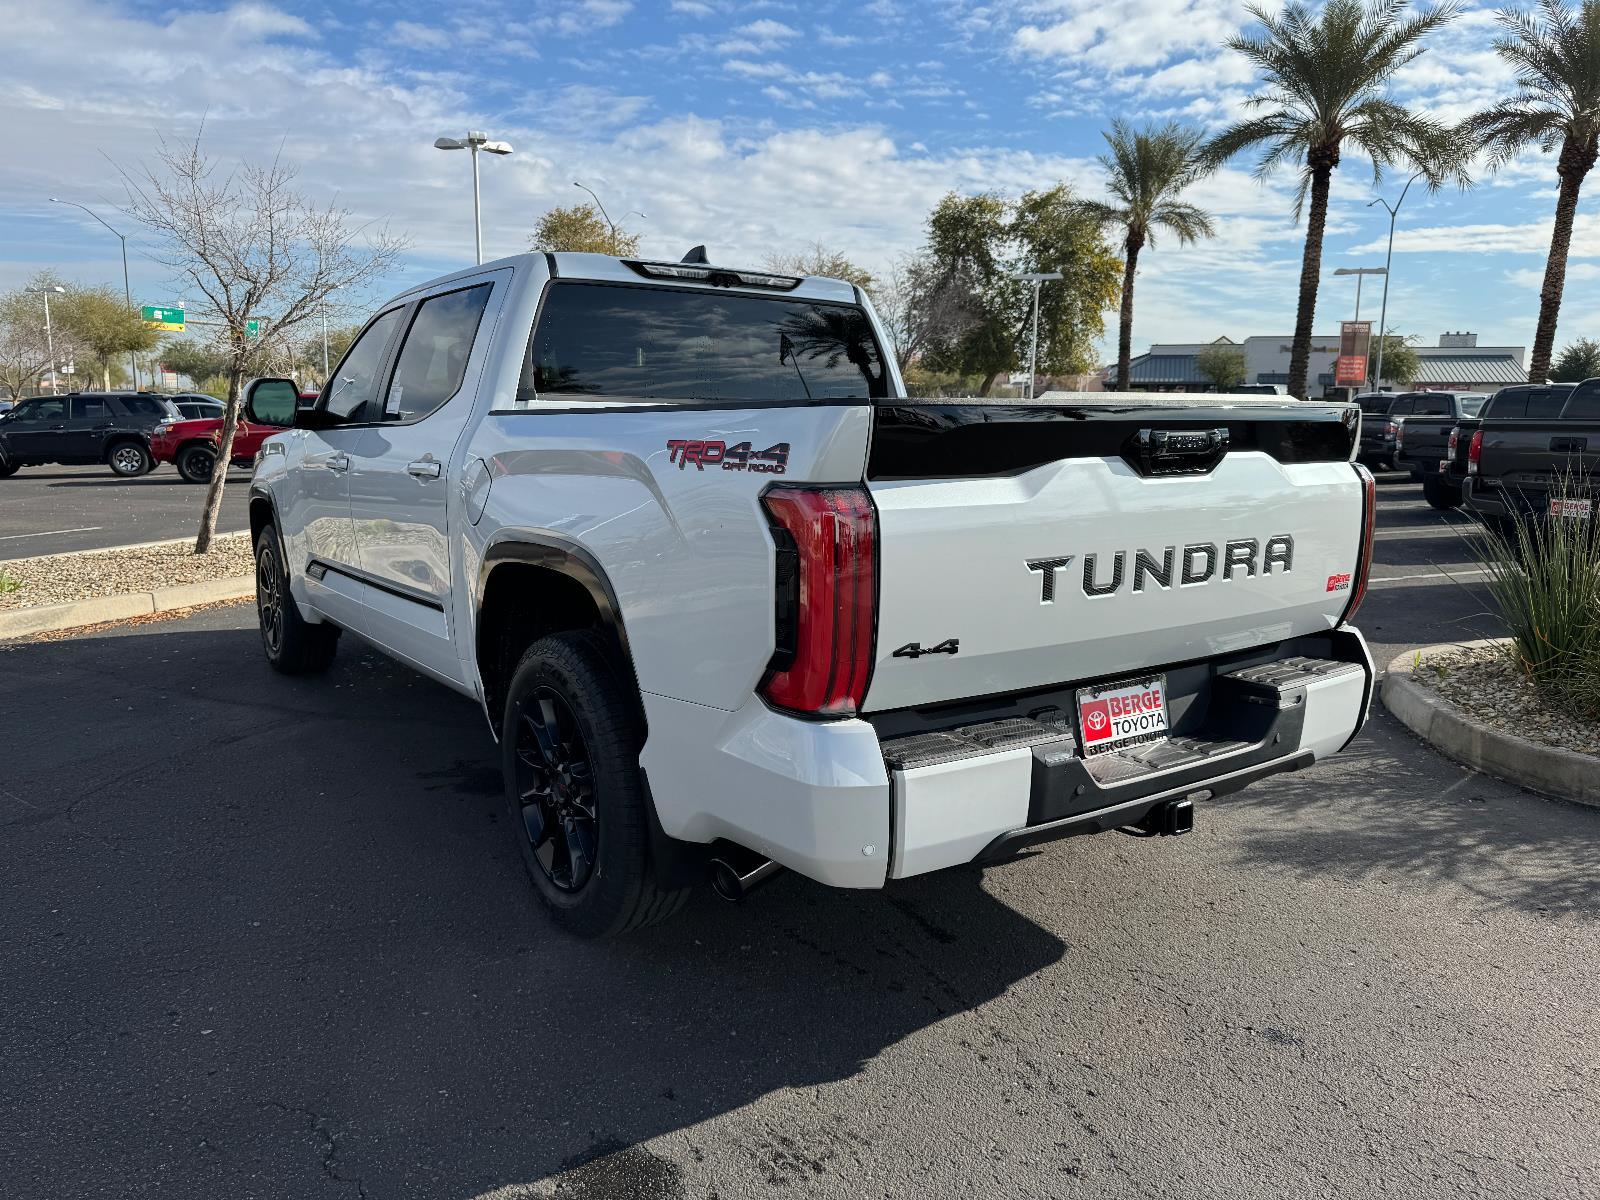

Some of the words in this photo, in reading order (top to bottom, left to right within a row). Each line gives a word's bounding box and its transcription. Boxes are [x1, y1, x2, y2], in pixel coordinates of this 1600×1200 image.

[666, 439, 726, 472] TRD
[725, 441, 791, 464] 4x4
[721, 461, 747, 472] OFF
[747, 462, 786, 475] ROAD
[1024, 534, 1294, 605] TUNDRA
[893, 638, 960, 659] 4x4
[1109, 689, 1162, 718] BERGE
[1112, 712, 1166, 736] TOYOTA
[1089, 737, 1130, 757] BERGE
[1132, 730, 1167, 746] TOYOTA
